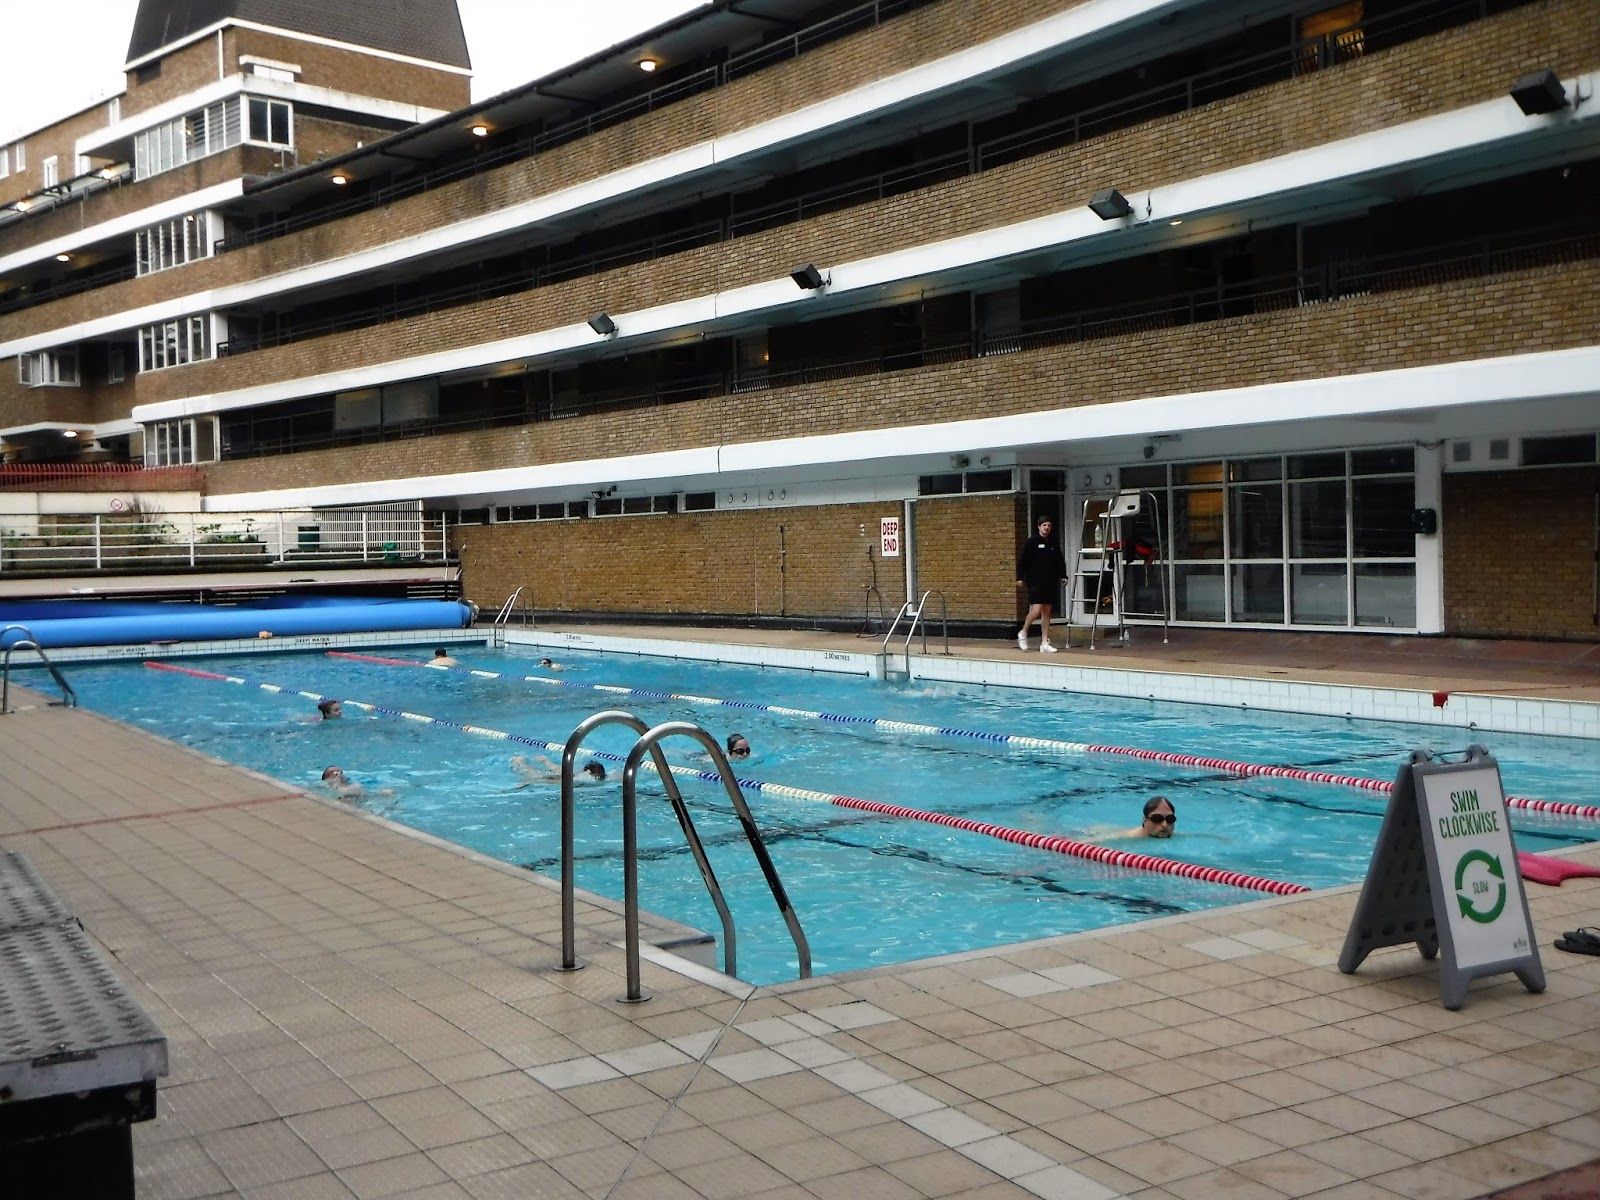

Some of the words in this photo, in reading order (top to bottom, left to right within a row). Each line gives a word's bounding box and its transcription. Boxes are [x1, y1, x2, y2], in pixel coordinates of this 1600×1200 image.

[883, 522, 898, 536] DEEP
[884, 538, 897, 552] END
[1450, 789, 1480, 813] SWIM
[1438, 810, 1500, 839] CLOCKWISE
[1472, 880, 1489, 894] SLOW
